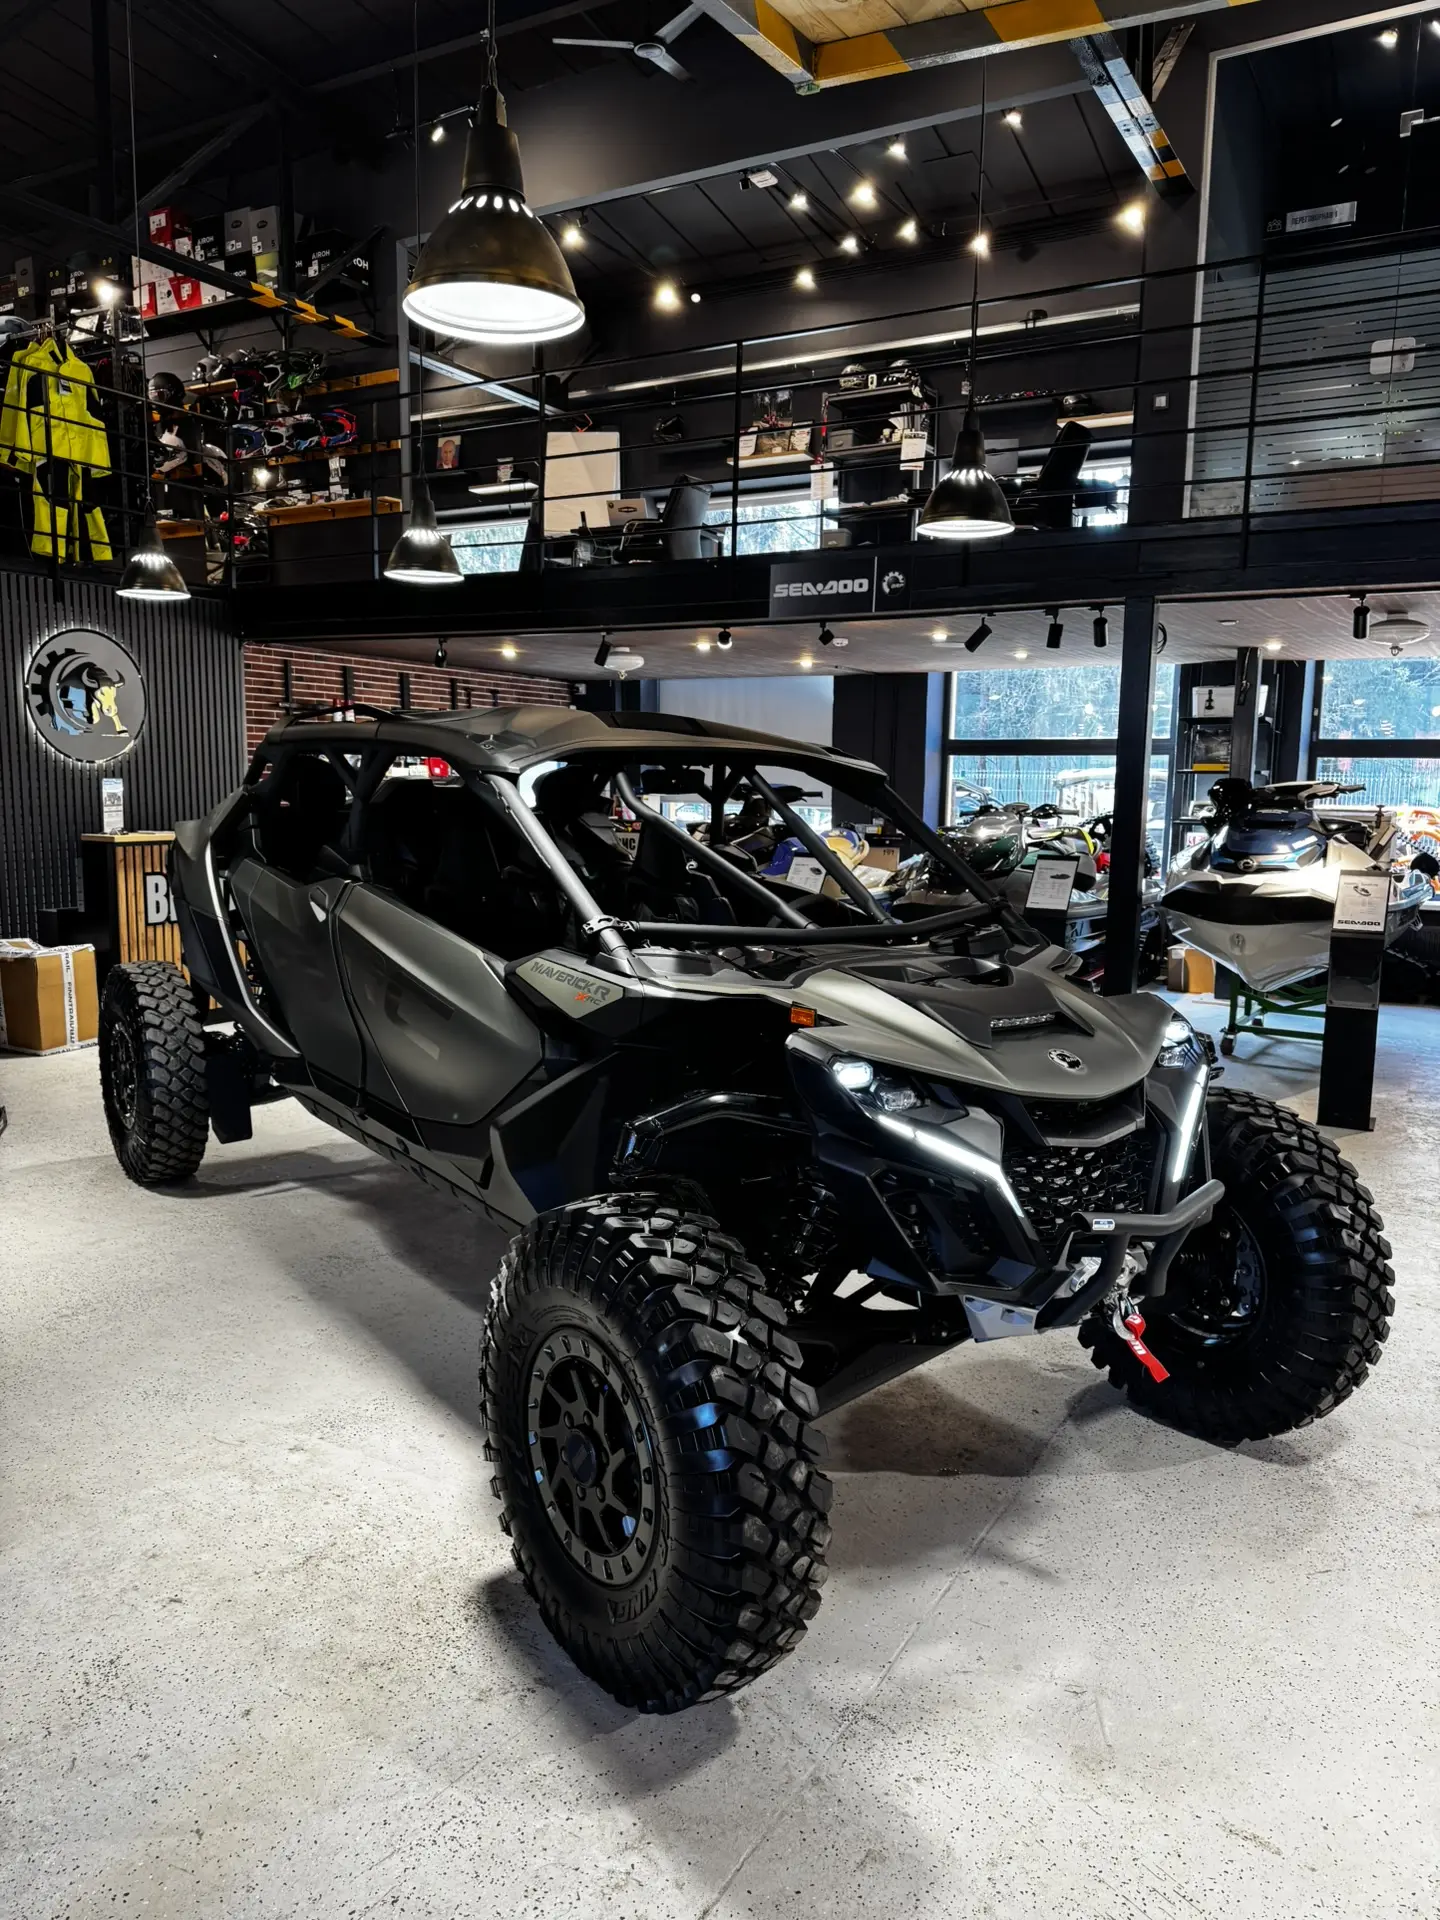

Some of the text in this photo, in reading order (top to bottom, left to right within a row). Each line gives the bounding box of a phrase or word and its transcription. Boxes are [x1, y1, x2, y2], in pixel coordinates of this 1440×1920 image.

[311, 249, 331, 260] AIROH
[530, 961, 611, 1001] MAVERICK R
